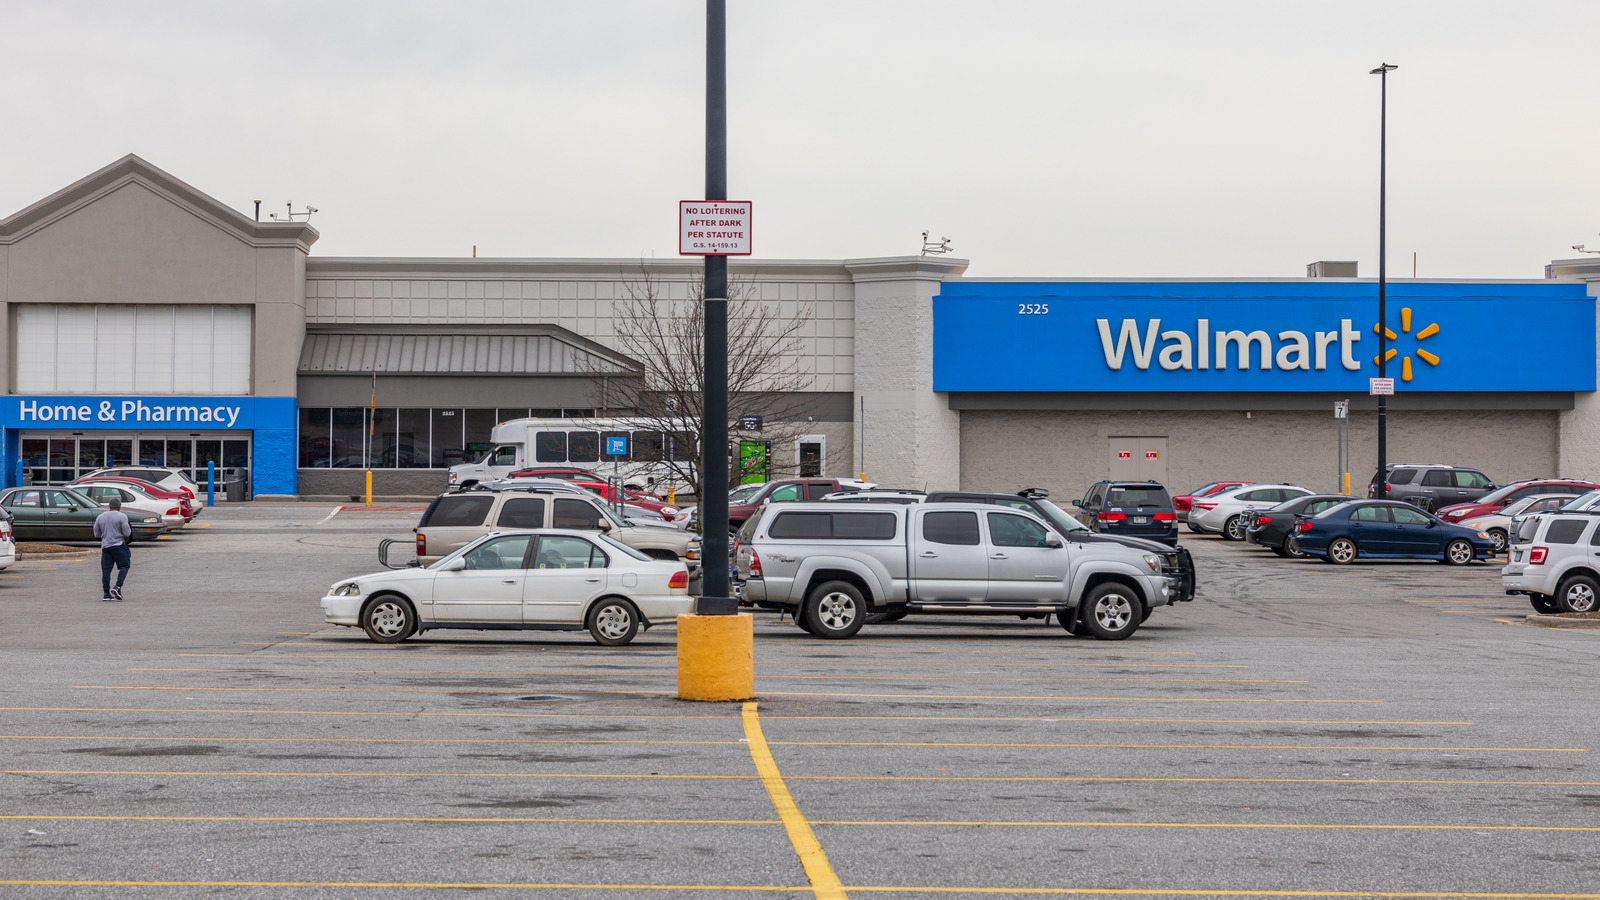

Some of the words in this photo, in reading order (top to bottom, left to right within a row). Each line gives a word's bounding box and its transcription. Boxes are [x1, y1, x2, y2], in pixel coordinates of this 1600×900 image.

[689, 219, 717, 227] AFTER
[718, 219, 742, 227] DARK
[687, 231, 704, 239] PER
[706, 231, 744, 239] STATUTE
[1018, 303, 1049, 315] 2525
[1096, 318, 1361, 371] Walmart
[20, 400, 92, 422] Home
[97, 400, 116, 422] &
[121, 400, 241, 428] Pharmacy
[1337, 407, 1343, 418] 7
